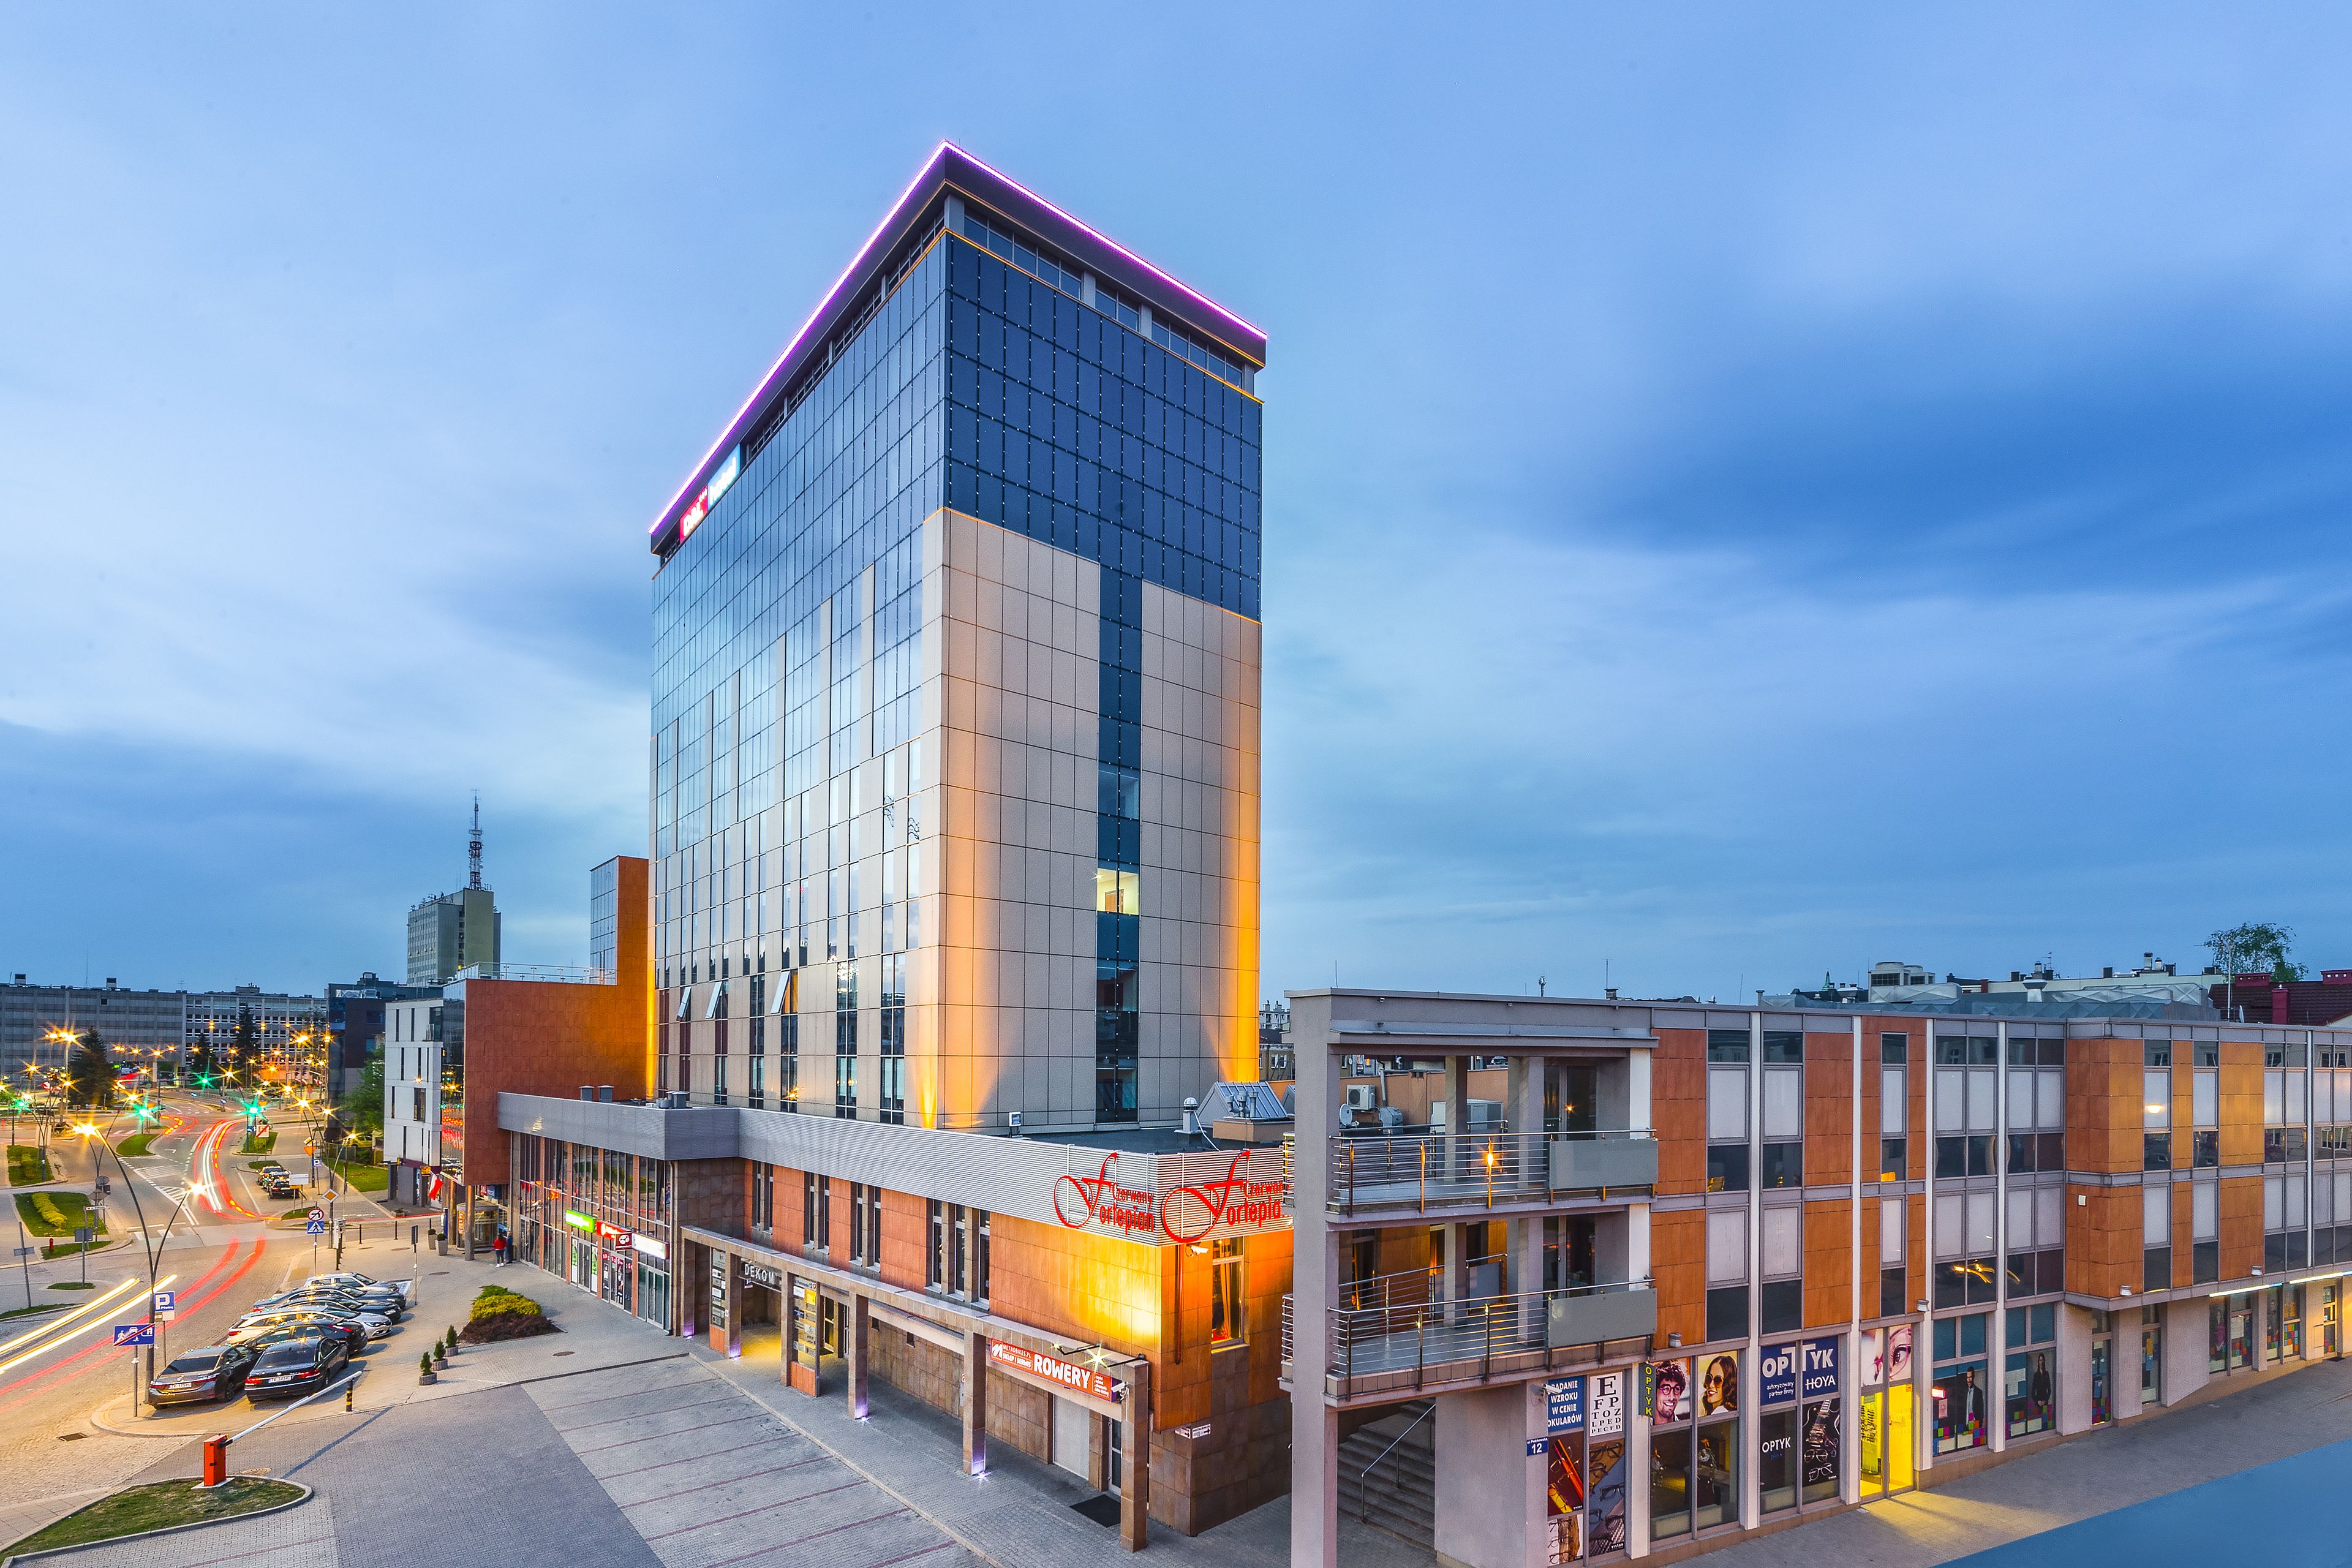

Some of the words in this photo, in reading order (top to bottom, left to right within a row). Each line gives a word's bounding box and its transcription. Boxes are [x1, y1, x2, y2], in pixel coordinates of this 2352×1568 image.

[1054, 1152, 1154, 1235] Fortepian
[1112, 1182, 1153, 1208] Czerwony
[1163, 1150, 1291, 1243] Fortepia
[1244, 1180, 1289, 1197] Czerwon
[745, 1264, 775, 1284] DEKOM
[156, 1294, 170, 1310] P
[1003, 1344, 1031, 1358] METROBIKES.PL
[1034, 1354, 1091, 1389] ROWERY
[1597, 1376, 1616, 1397] E
[1766, 1382, 1795, 1390] autoryzowany
[1805, 1374, 1836, 1390] HOYA
[1551, 1392, 1578, 1403] WZROKU
[1769, 1390, 1783, 1399] partner
[1552, 1406, 1558, 1415] W
[1559, 1403, 1577, 1414] CENIE
[1594, 1399, 1604, 1410] F
[1609, 1396, 1619, 1408] P
[1548, 1413, 1582, 1428] OKULARÓW
[1532, 1443, 1542, 1454] 12
[1762, 1437, 1791, 1453] OPTYK
